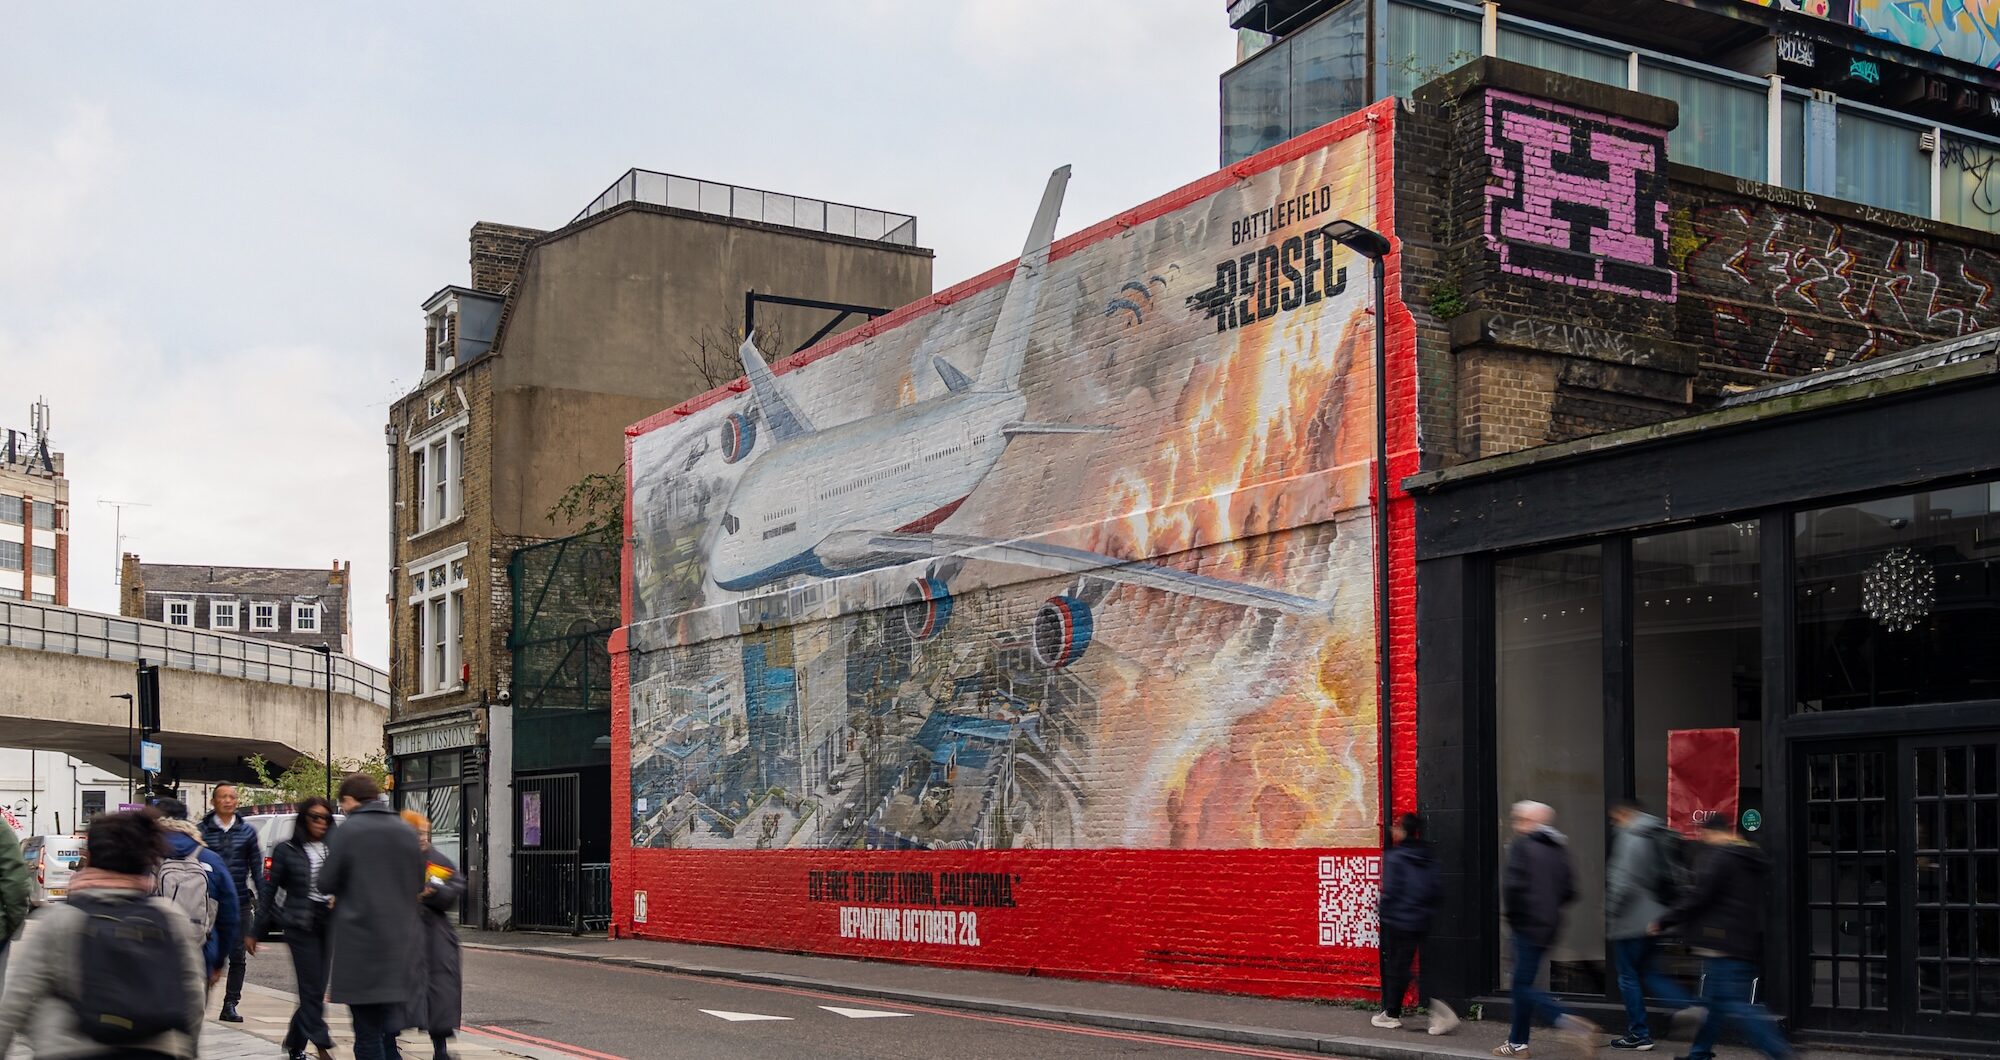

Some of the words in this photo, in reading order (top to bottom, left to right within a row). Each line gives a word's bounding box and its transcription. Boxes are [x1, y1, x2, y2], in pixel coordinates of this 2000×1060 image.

[1232, 185, 1331, 246] BATTLEFIELD
[1214, 228, 1347, 333] REDSEC
[405, 734, 422, 753] THE
[427, 725, 466, 750] MISSION
[635, 893, 646, 916] 16
[809, 871, 824, 901] FLY
[826, 871, 849, 901] FREE
[851, 871, 865, 902] TO
[868, 872, 896, 903] FORT
[840, 906, 900, 941] DEPARTING
[902, 909, 956, 945] OCTOBER
[959, 911, 980, 946] 28.
